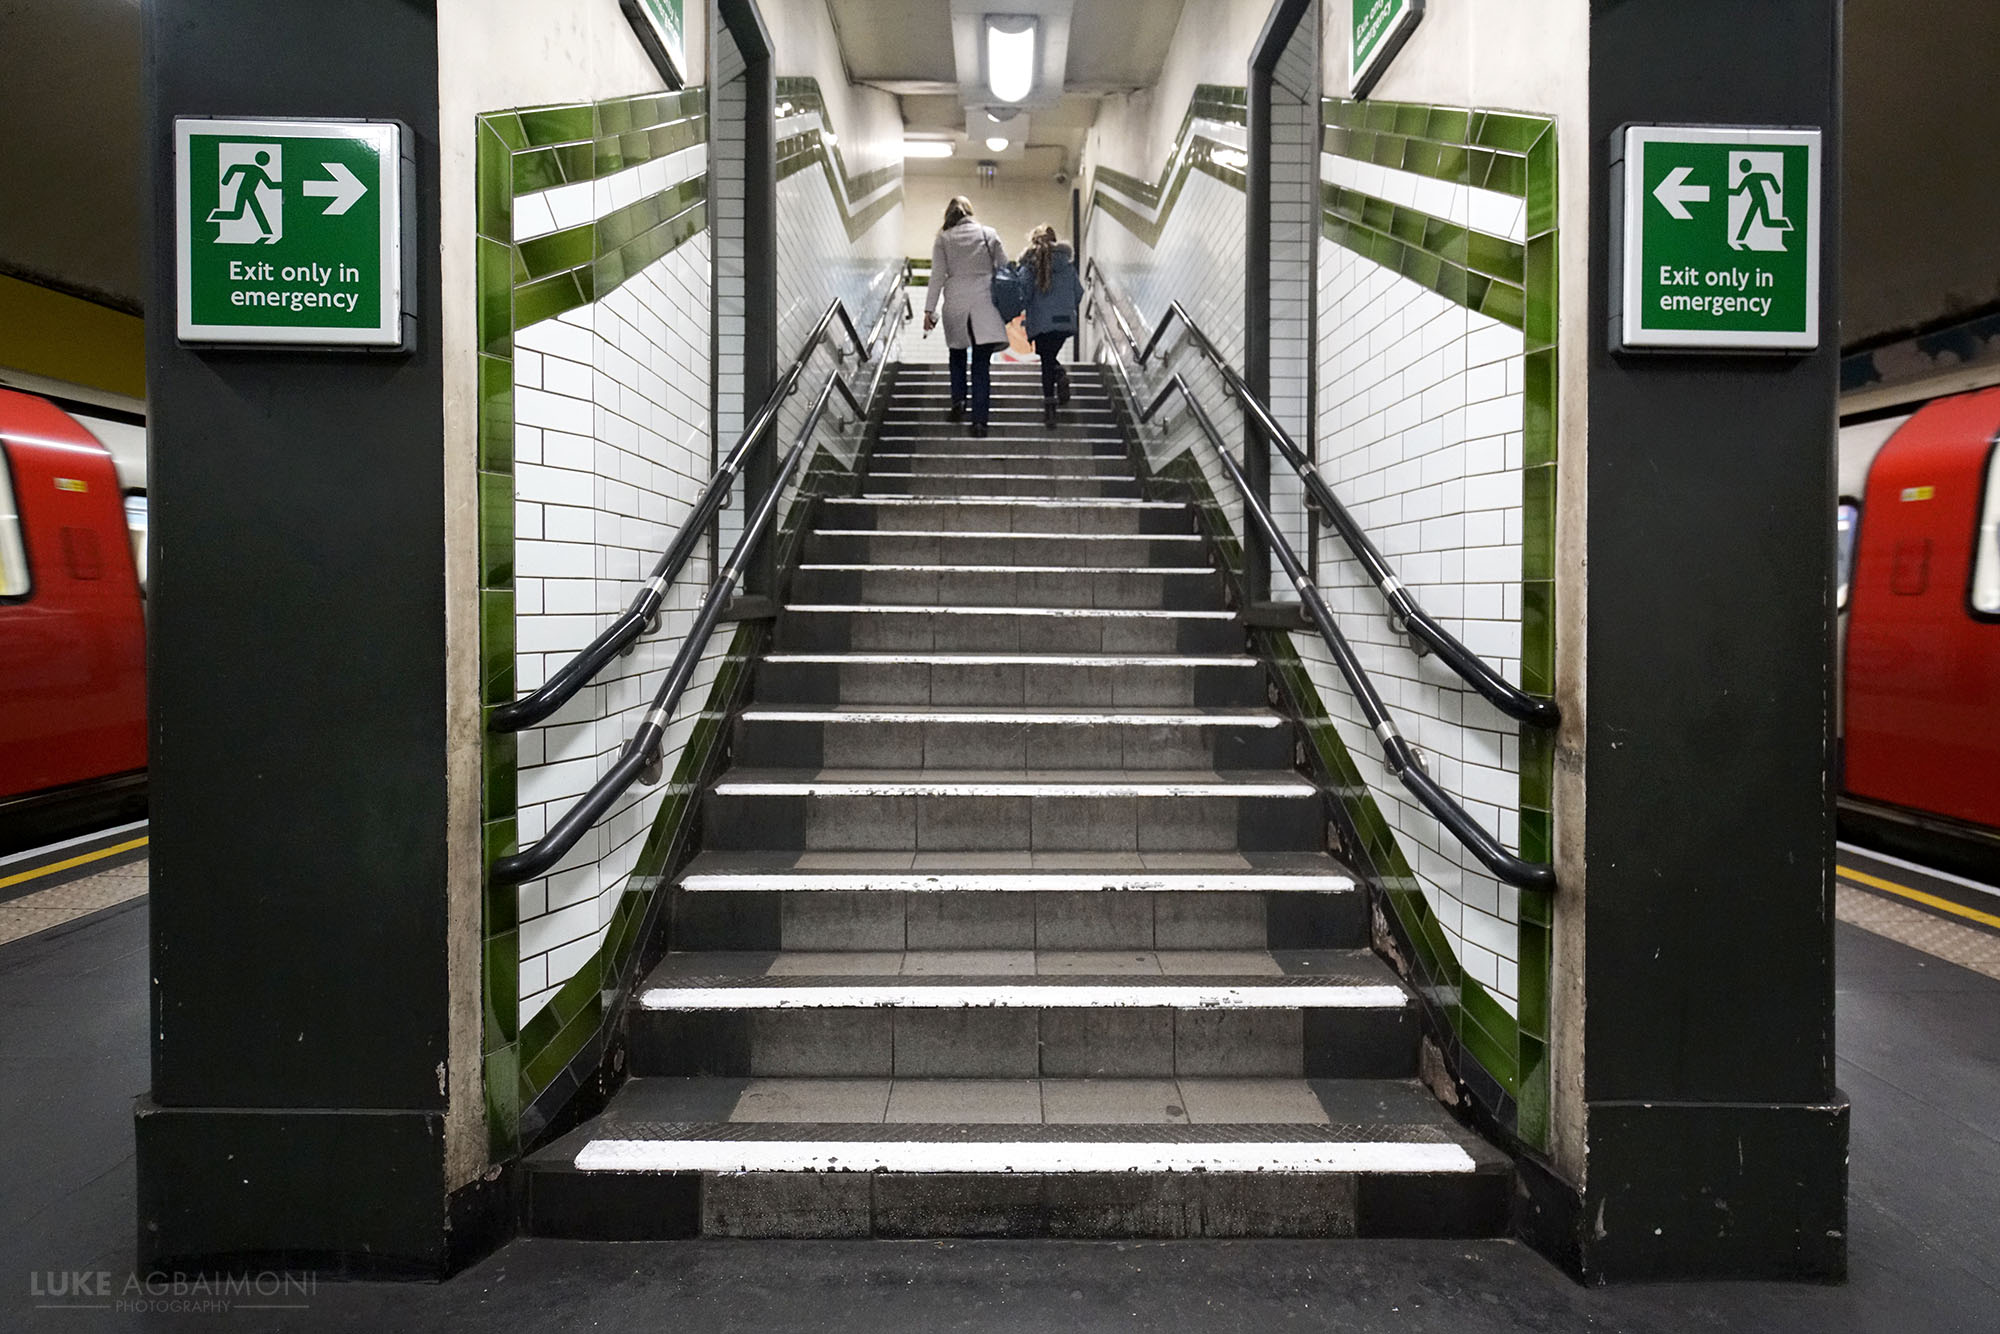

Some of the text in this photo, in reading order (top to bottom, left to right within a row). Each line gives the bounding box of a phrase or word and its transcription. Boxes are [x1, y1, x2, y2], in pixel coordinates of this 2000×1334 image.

[1357, 14, 1369, 40] Exit
[229, 261, 360, 287] Exit only in
[1660, 265, 1773, 291] Exit only in
[230, 290, 359, 313] emergency
[1660, 295, 1772, 317] emergency
